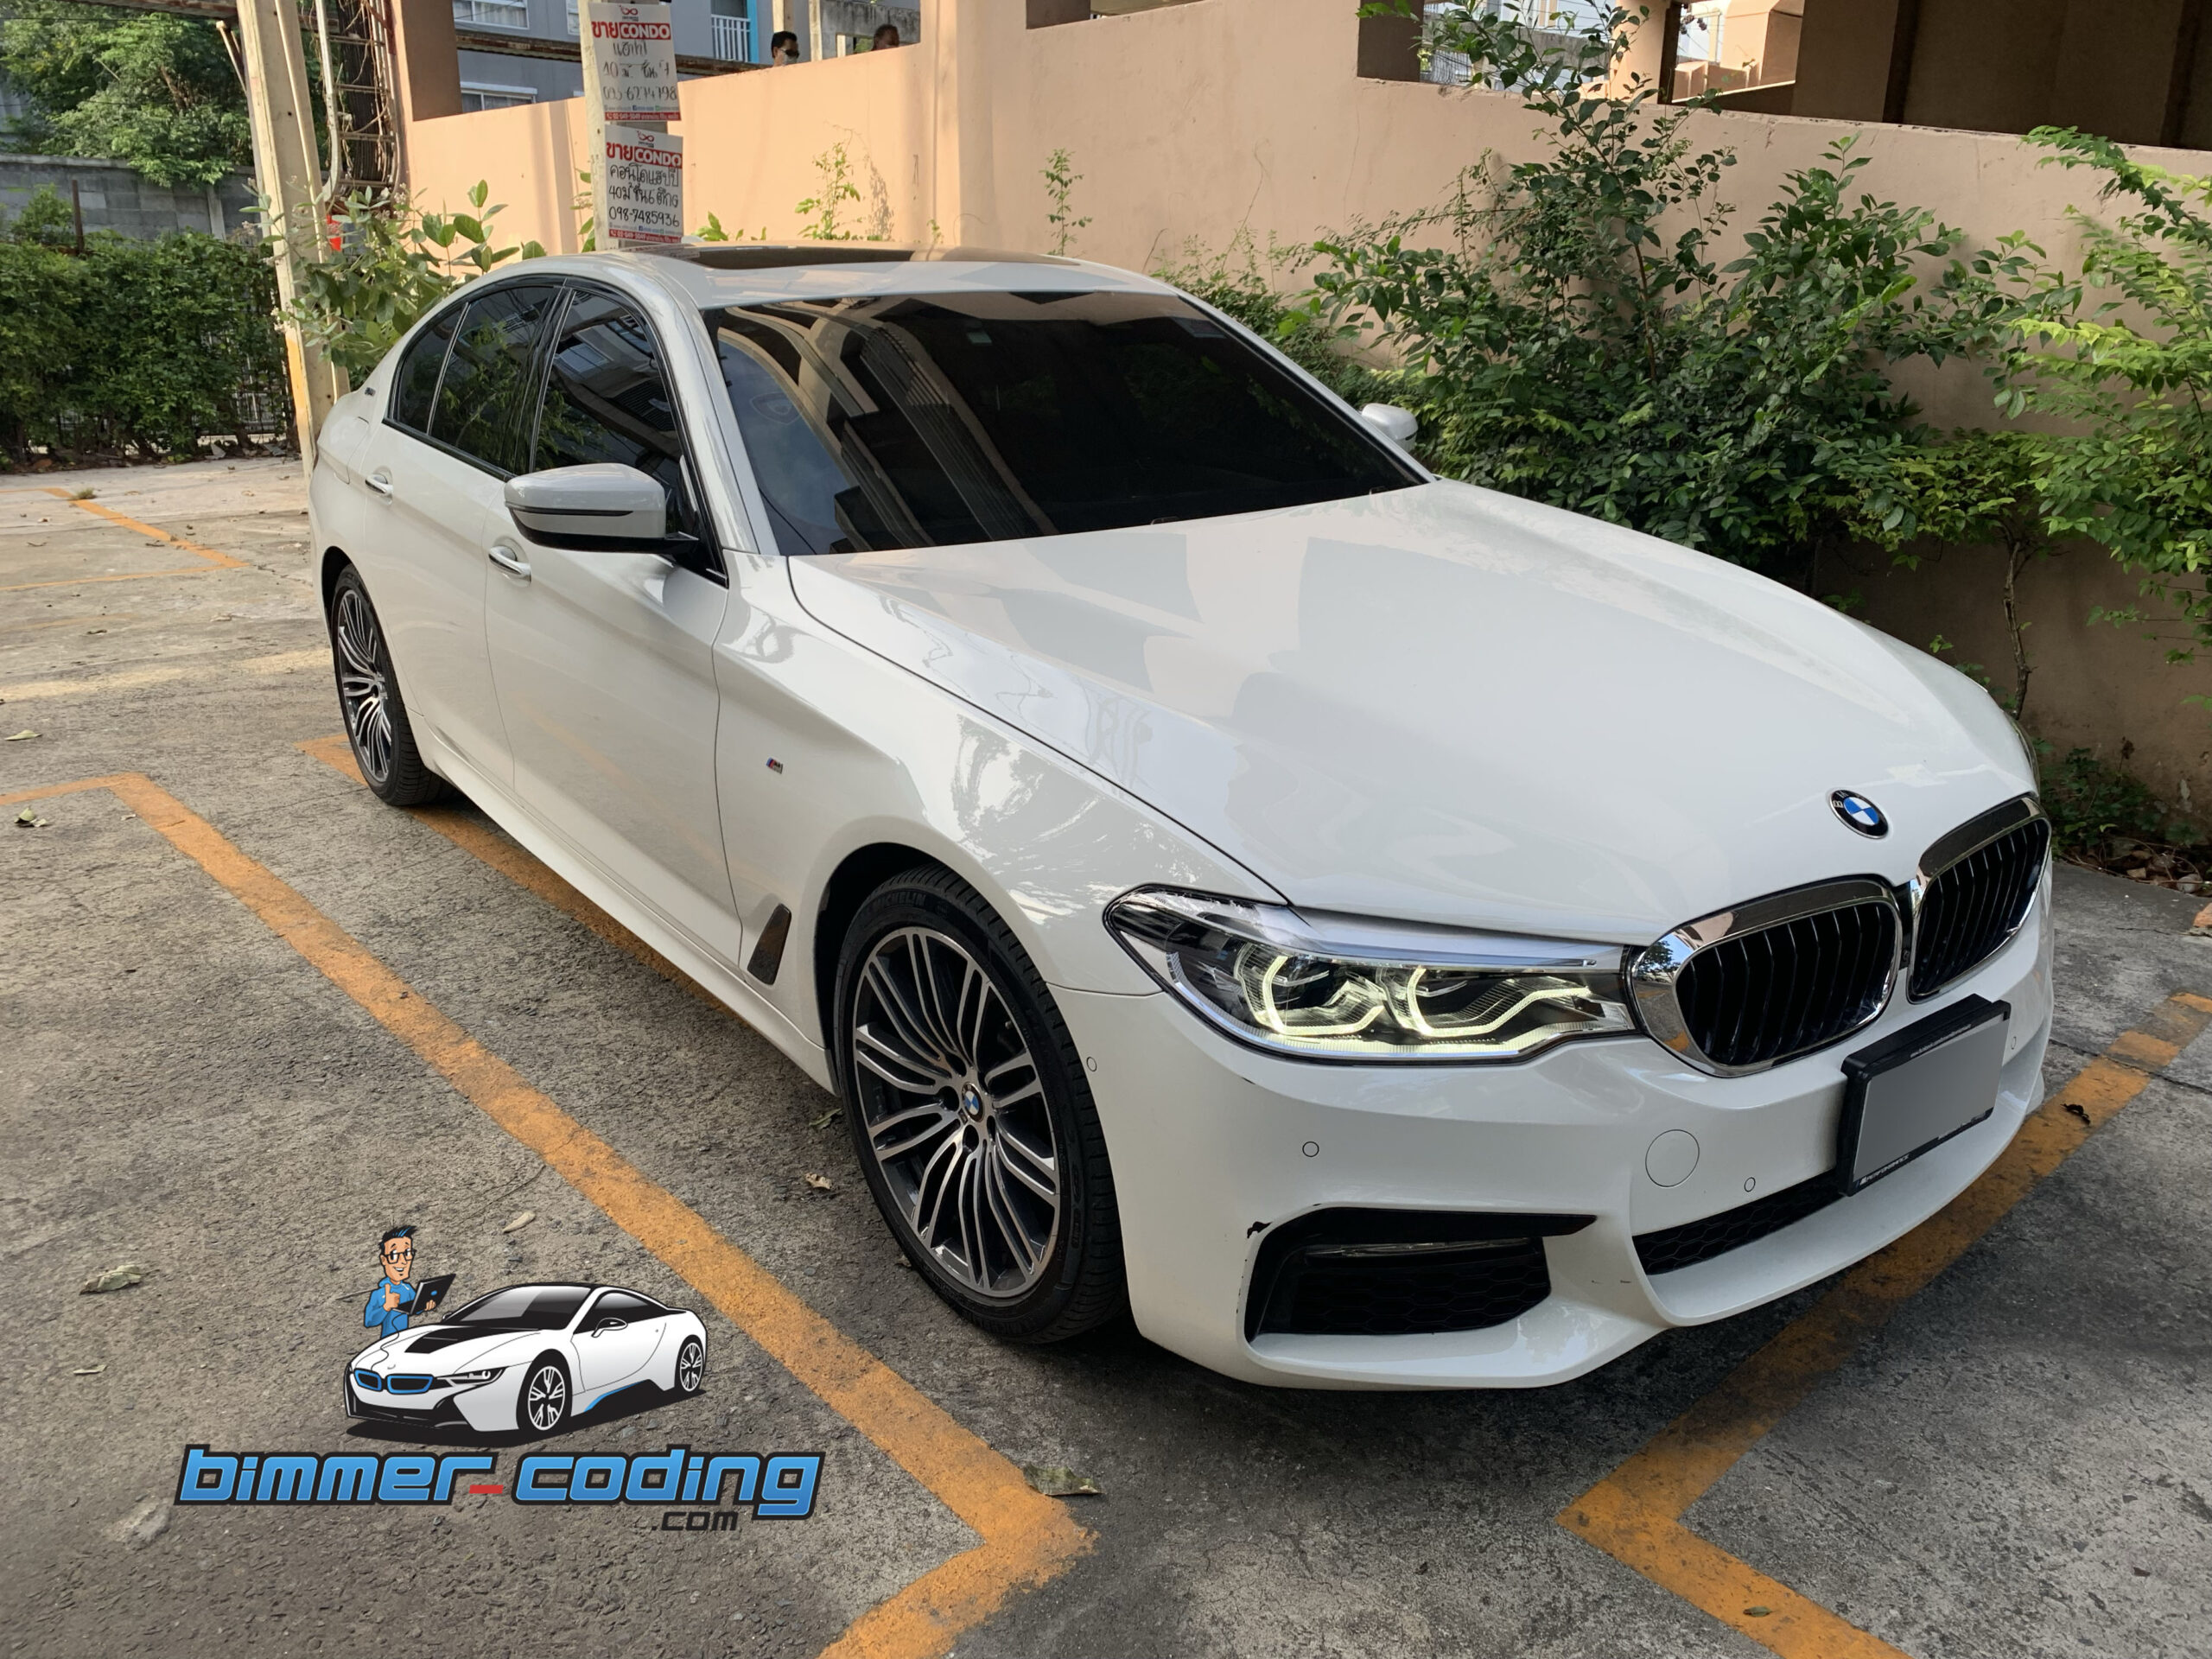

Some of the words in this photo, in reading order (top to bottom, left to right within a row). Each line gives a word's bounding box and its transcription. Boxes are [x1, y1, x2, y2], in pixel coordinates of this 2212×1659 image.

[591, 22, 619, 38] ขาย
[620, 24, 671, 39] CONDO
[606, 142, 633, 162] ขาย
[635, 148, 682, 167] CONDO
[608, 206, 680, 227] 098-7485936
